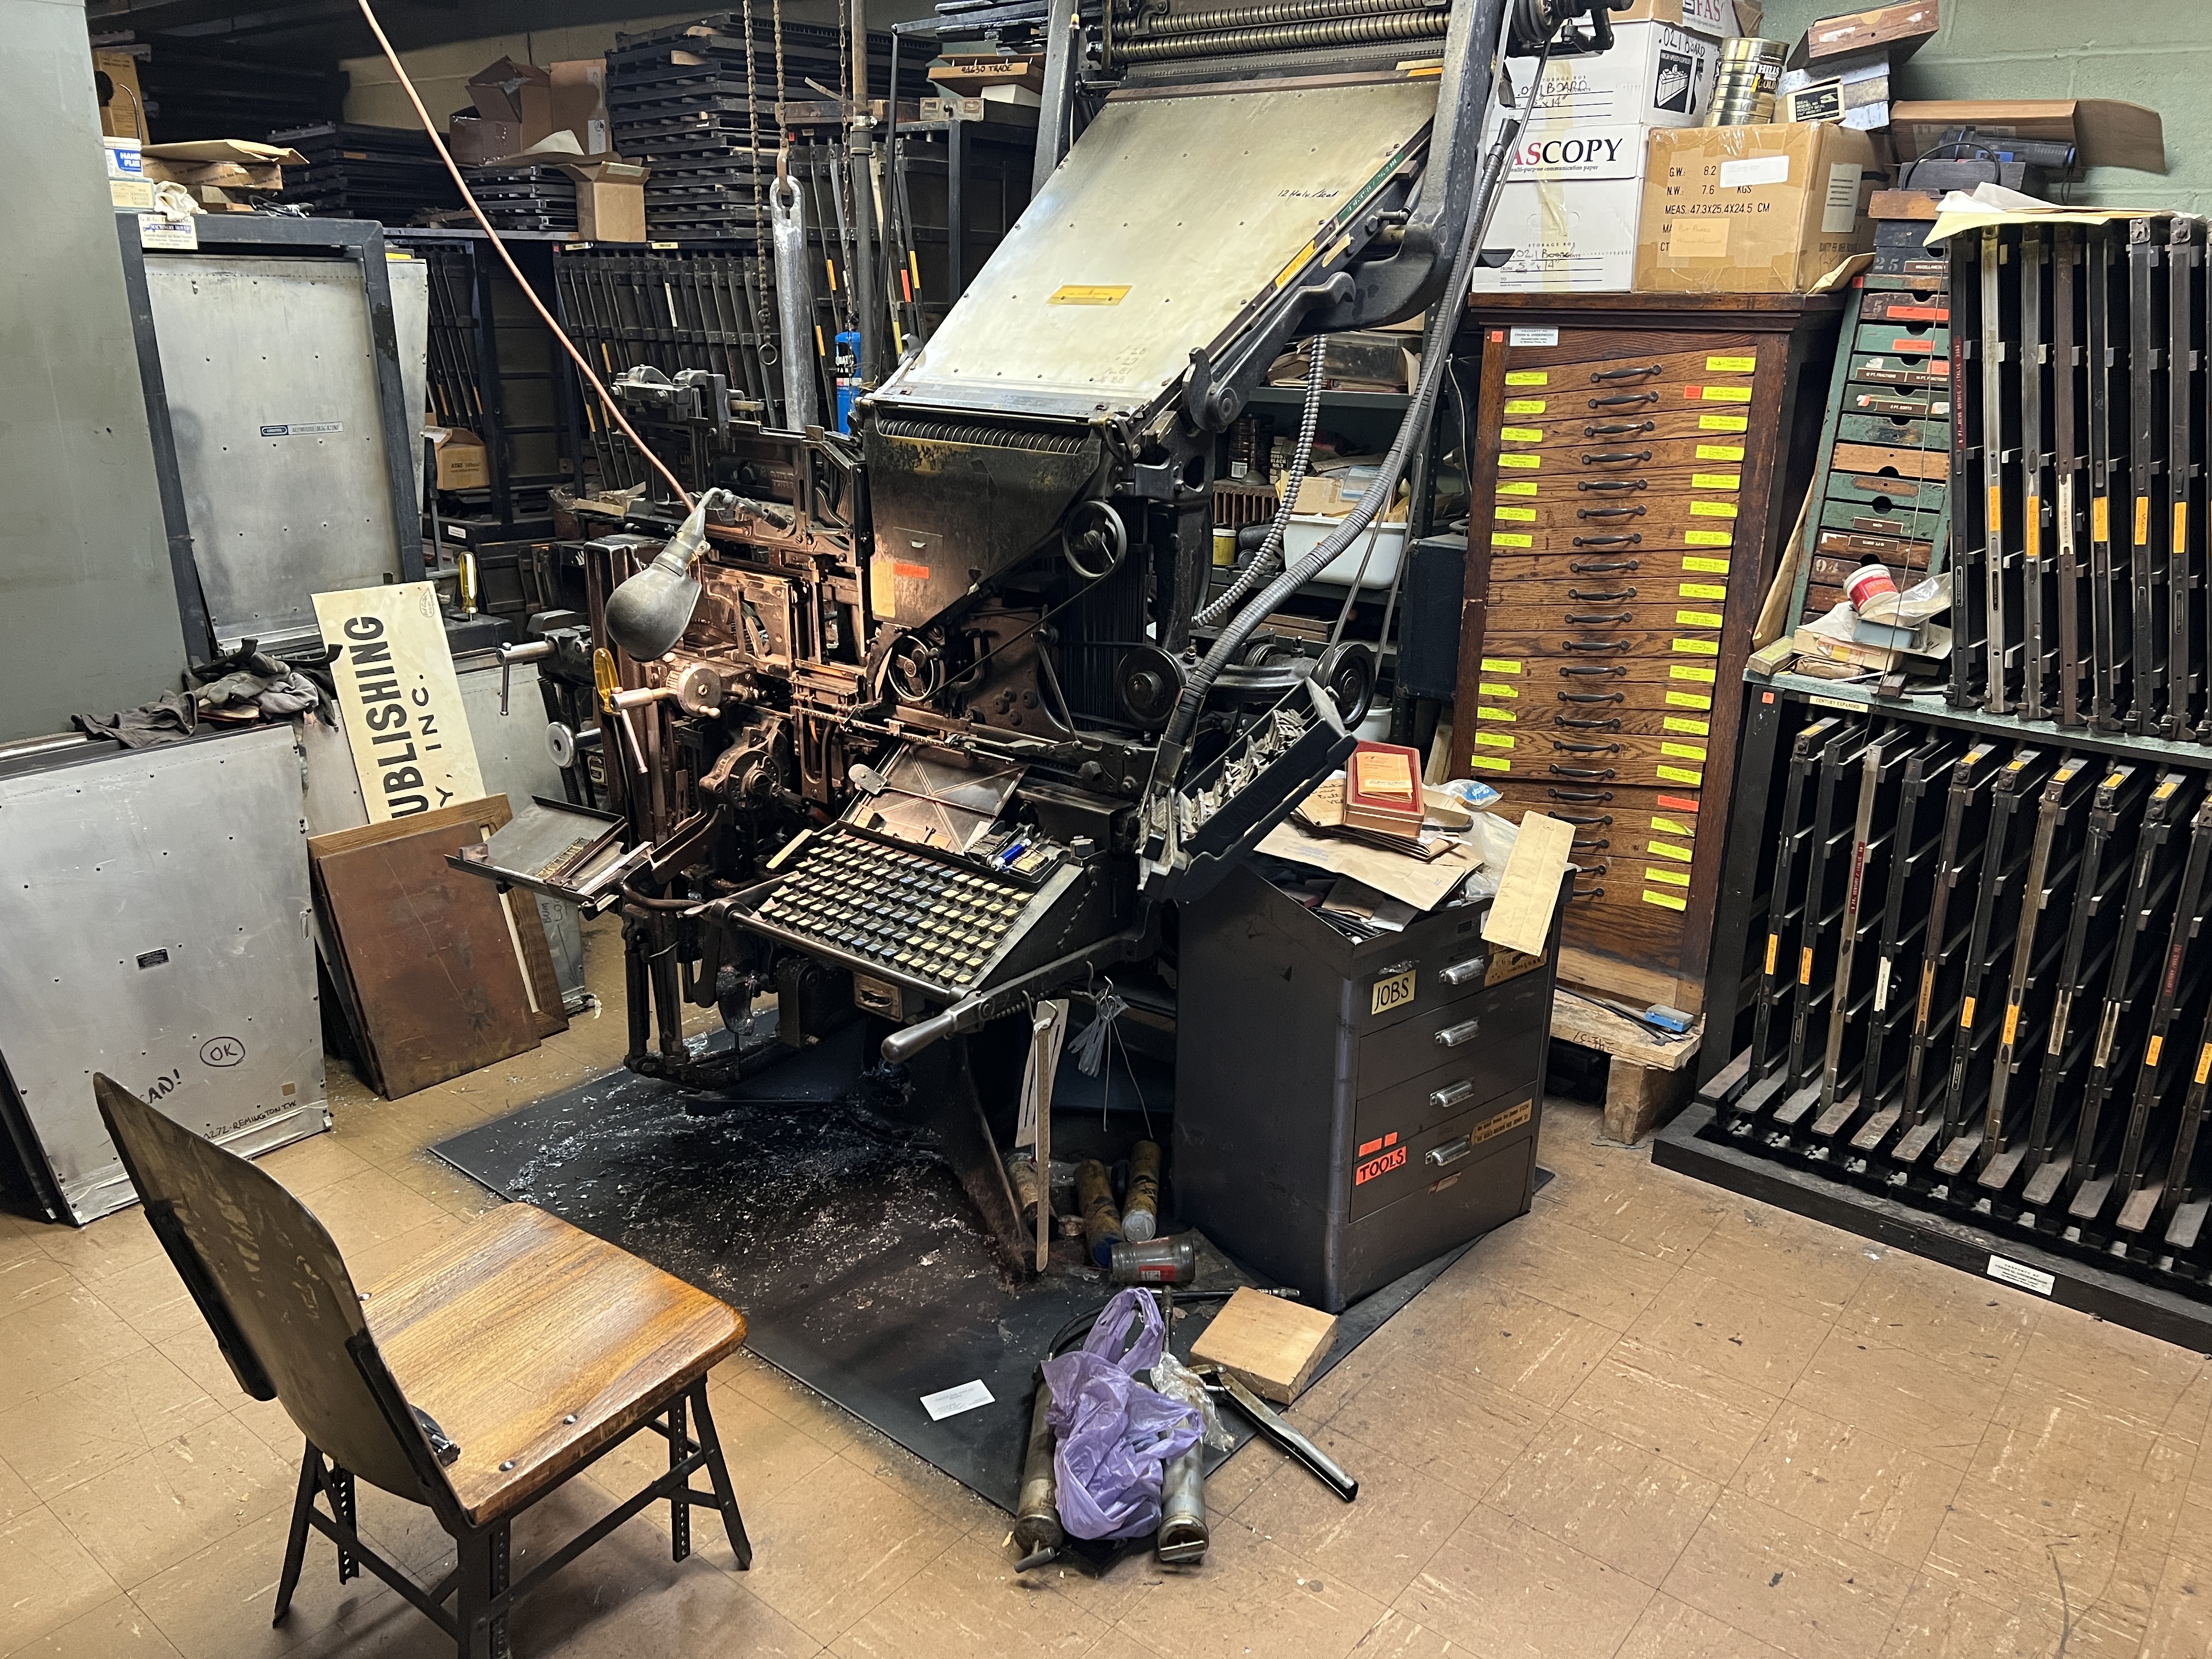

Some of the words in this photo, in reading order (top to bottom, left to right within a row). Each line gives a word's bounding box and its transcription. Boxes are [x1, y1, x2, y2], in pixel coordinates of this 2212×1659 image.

[1757, 64, 1780, 76] HILLS
[1547, 80, 1587, 94] BOARD
[1758, 80, 1777, 90] GOLD
[1513, 138, 1623, 166] ASCOPY
[1703, 166, 1717, 176] 8.2
[1702, 185, 1716, 195] 7.6
[1737, 185, 1752, 194] KGS
[1757, 202, 1771, 213] CM
[1837, 701, 1860, 709] EXPANDED
[343, 616, 430, 819] UBLISHING
[411, 674, 442, 752] INC.
[1374, 977, 1409, 1012] JOBS
[210, 1043, 238, 1061] OK
[1359, 1148, 1405, 1181] TOOLS
